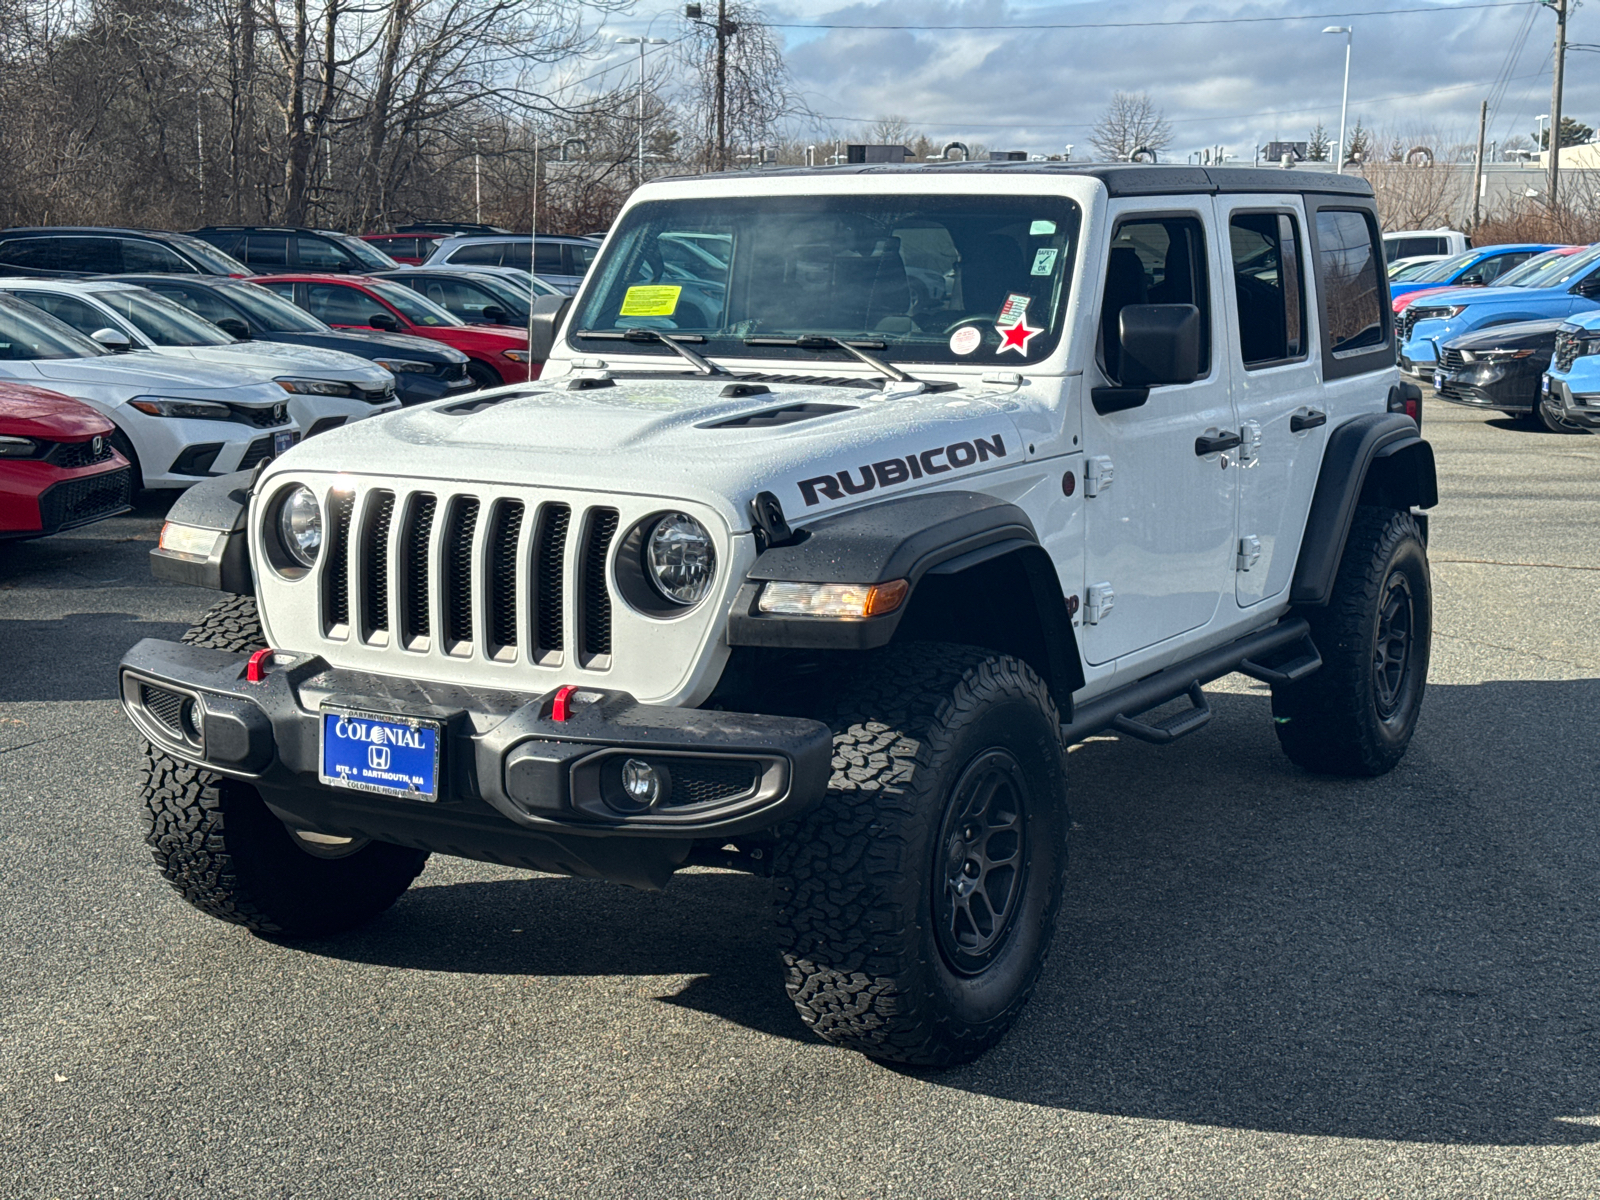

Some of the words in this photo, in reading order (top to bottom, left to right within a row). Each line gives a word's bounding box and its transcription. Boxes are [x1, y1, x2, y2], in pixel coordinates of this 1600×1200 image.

[797, 433, 1007, 507] RUBICON
[335, 721, 426, 749] COLONIAL
[335, 764, 351, 774] RTE.
[412, 775, 424, 785] MA
[347, 781, 381, 793] COLONIAL
